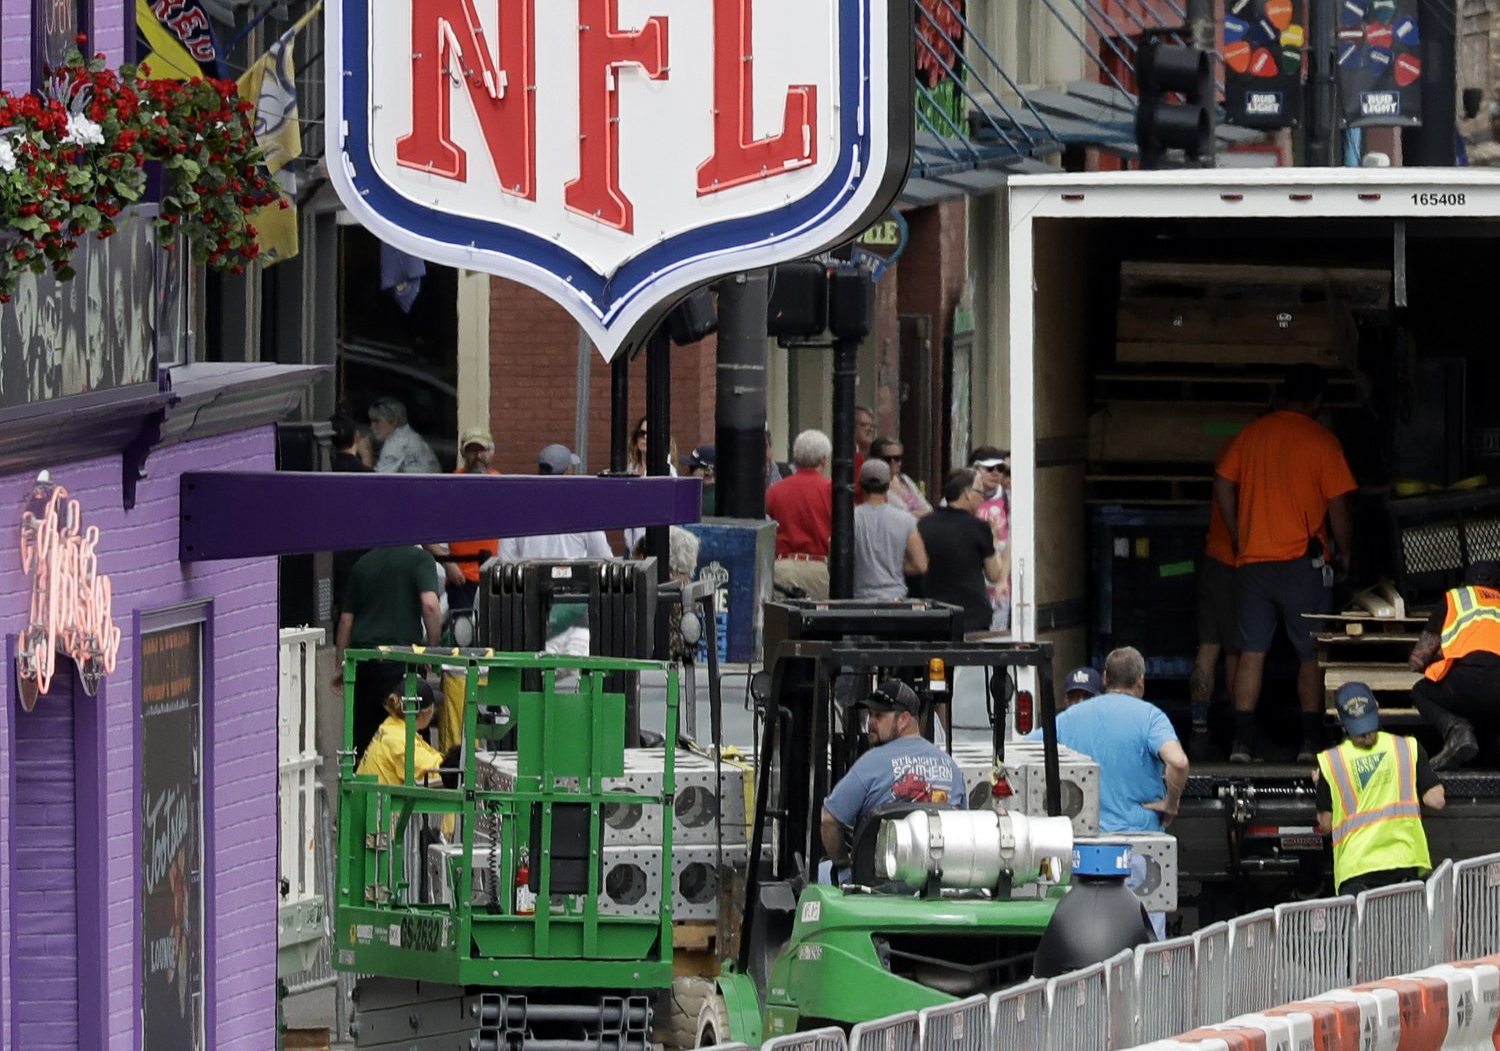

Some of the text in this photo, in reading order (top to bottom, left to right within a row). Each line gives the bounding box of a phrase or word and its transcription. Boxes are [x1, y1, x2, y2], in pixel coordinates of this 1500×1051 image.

[1252, 94, 1276, 103] BUD
[1367, 94, 1394, 104] BUD
[1246, 101, 1281, 113] LIGHT
[1362, 101, 1398, 114] LIGHT
[1411, 193, 1466, 206] 165408
[891, 756, 939, 767] STRAIGHT
[893, 764, 953, 781] SOUTHERN
